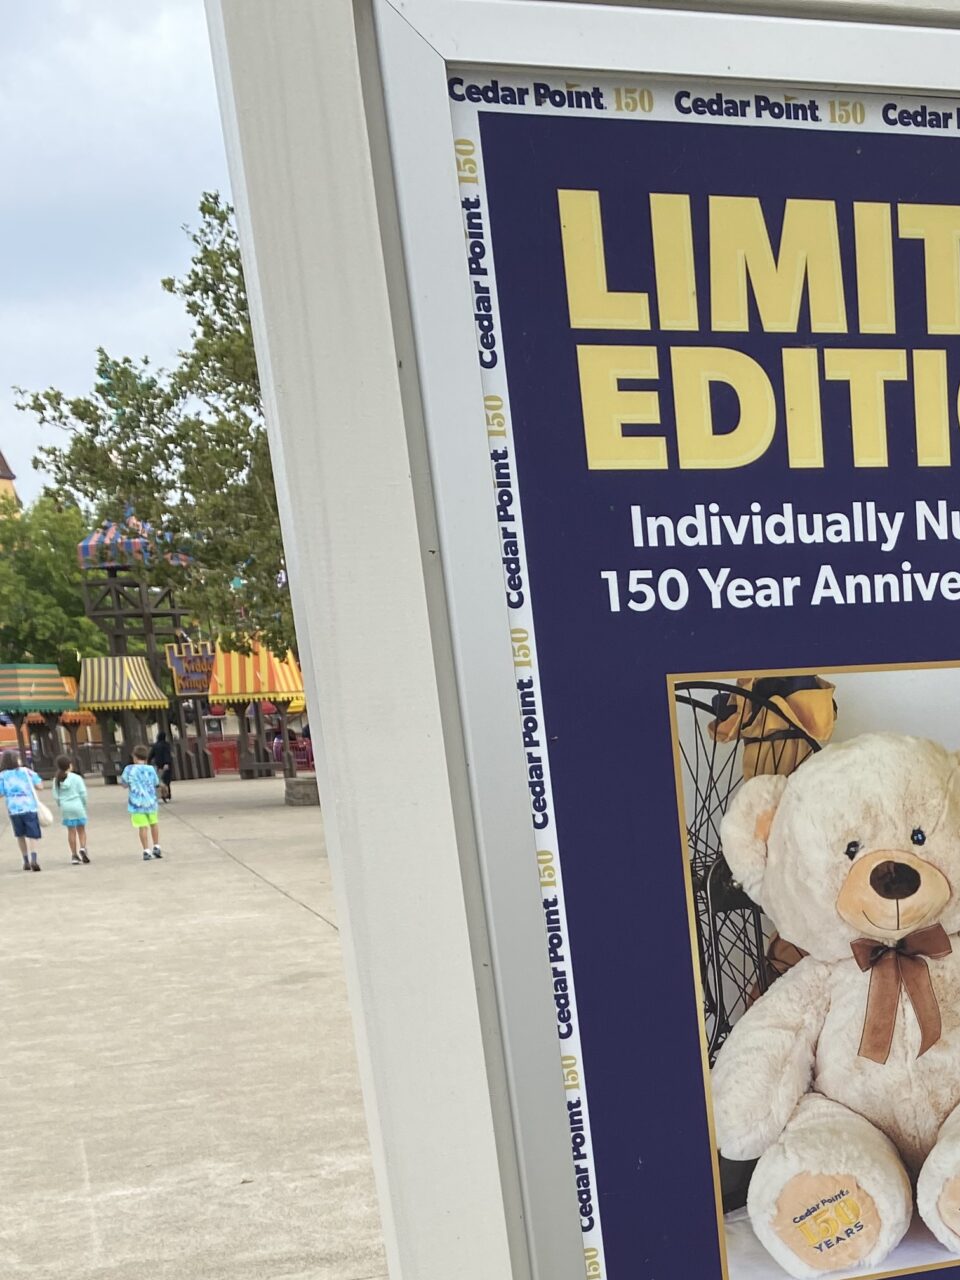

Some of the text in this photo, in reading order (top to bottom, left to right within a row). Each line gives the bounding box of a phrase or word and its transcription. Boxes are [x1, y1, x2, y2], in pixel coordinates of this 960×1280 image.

[448, 77, 528, 106] Cedar
[533, 82, 604, 110] Point
[613, 87, 654, 112] 150
[675, 91, 749, 117] Cedar
[755, 95, 820, 121] Point
[828, 101, 865, 125] 150
[882, 103, 952, 130] Cedar
[454, 138, 479, 185] 150
[461, 196, 488, 276] Point
[473, 281, 497, 369] Cedar
[484, 395, 507, 438] 150
[490, 448, 515, 522] Point
[630, 502, 904, 551] Individually
[502, 527, 524, 609] Cedar
[600, 568, 689, 612] 150
[698, 567, 800, 609] Year
[511, 628, 532, 668] 150
[517, 678, 540, 748] Point
[527, 752, 549, 830] Cedar
[536, 850, 557, 888] 150
[543, 897, 565, 963] Point
[552, 967, 573, 1040] Cedar
[561, 1055, 580, 1091] 150
[567, 1099, 587, 1161] Point
[575, 1164, 595, 1232] Cedar
[793, 1189, 847, 1224] Cedar Point
[796, 1198, 860, 1246] 150
[814, 1221, 864, 1253] YEARS
